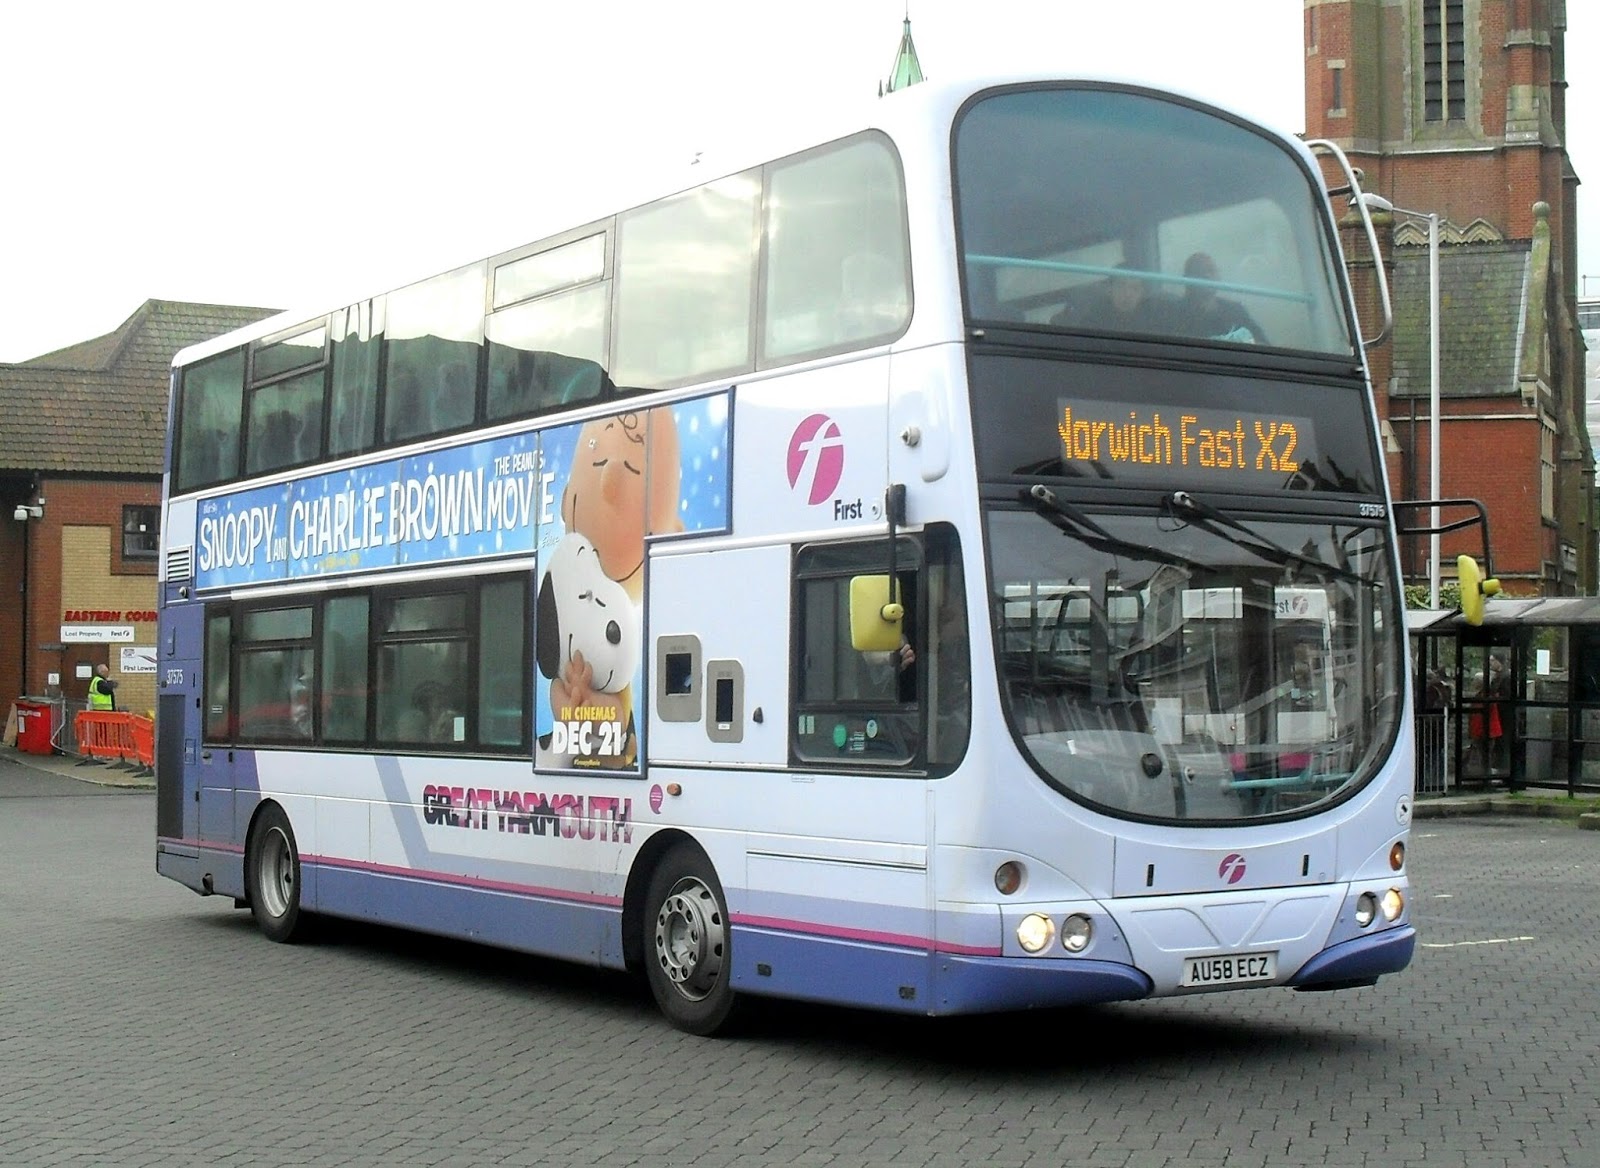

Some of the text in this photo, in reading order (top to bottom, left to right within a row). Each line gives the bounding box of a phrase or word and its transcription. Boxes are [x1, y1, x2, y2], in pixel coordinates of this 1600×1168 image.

[1180, 415, 1246, 469] Fast
[1254, 421, 1299, 472] X2
[494, 450, 544, 477] THE PEANUS
[486, 471, 556, 532] MOVE
[834, 498, 862, 521] First
[1359, 503, 1386, 518] 37575
[200, 503, 278, 572] SNOOPY
[272, 537, 287, 562] AN
[389, 467, 484, 545] BROWN
[64, 610, 122, 622] EASTERN
[79, 630, 103, 638] Property
[166, 668, 184, 685] 37575
[561, 706, 616, 721] IN CINEMAS
[552, 720, 622, 756] DEC 21
[1191, 957, 1269, 982] AU58 ECZ
